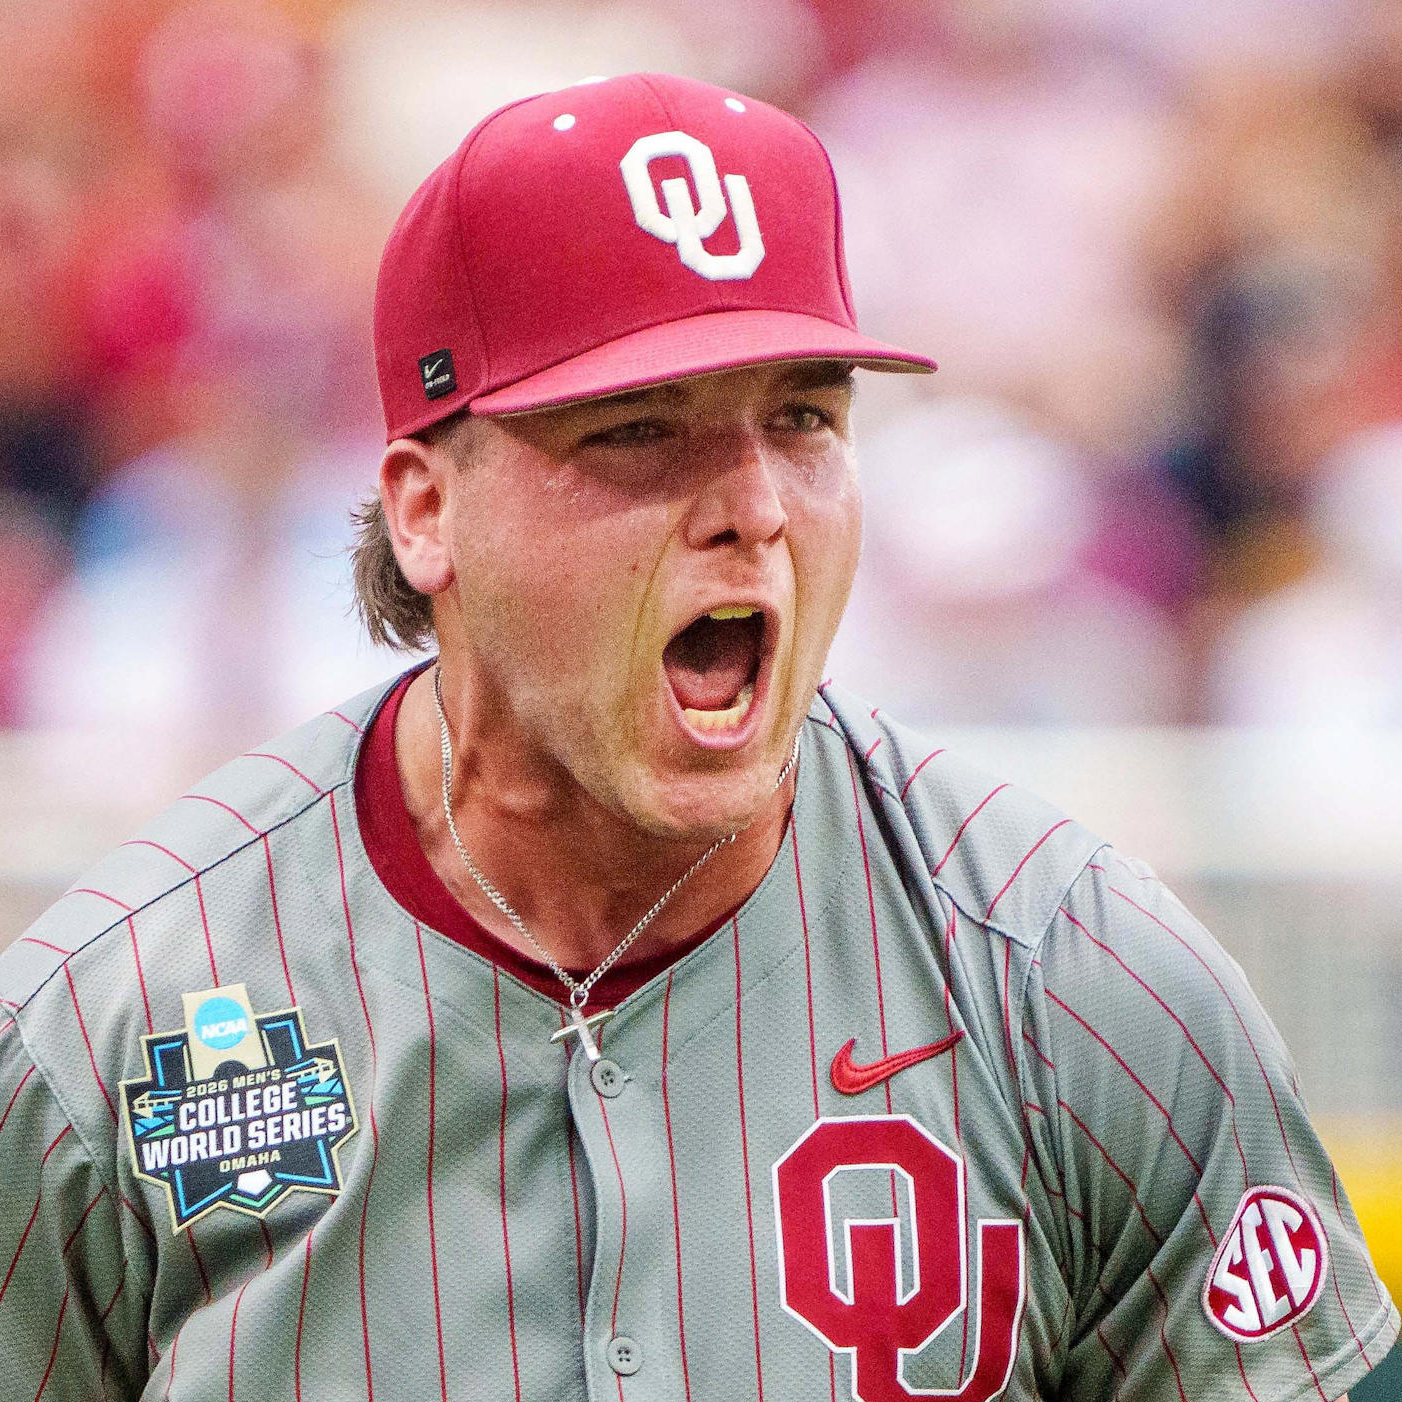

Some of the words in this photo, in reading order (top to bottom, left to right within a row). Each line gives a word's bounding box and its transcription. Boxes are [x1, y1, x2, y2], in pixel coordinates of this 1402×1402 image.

[619, 130, 766, 281] OU
[200, 1019, 248, 1039] NCAA
[179, 1081, 297, 1131] COLLEGE
[186, 1079, 228, 1099] 2026
[232, 1069, 282, 1088] MEN'S
[142, 1124, 242, 1171] WORLD
[248, 1102, 346, 1150] SERIES
[219, 1149, 281, 1173] OMAHA
[1213, 1199, 1316, 1332] SEC
